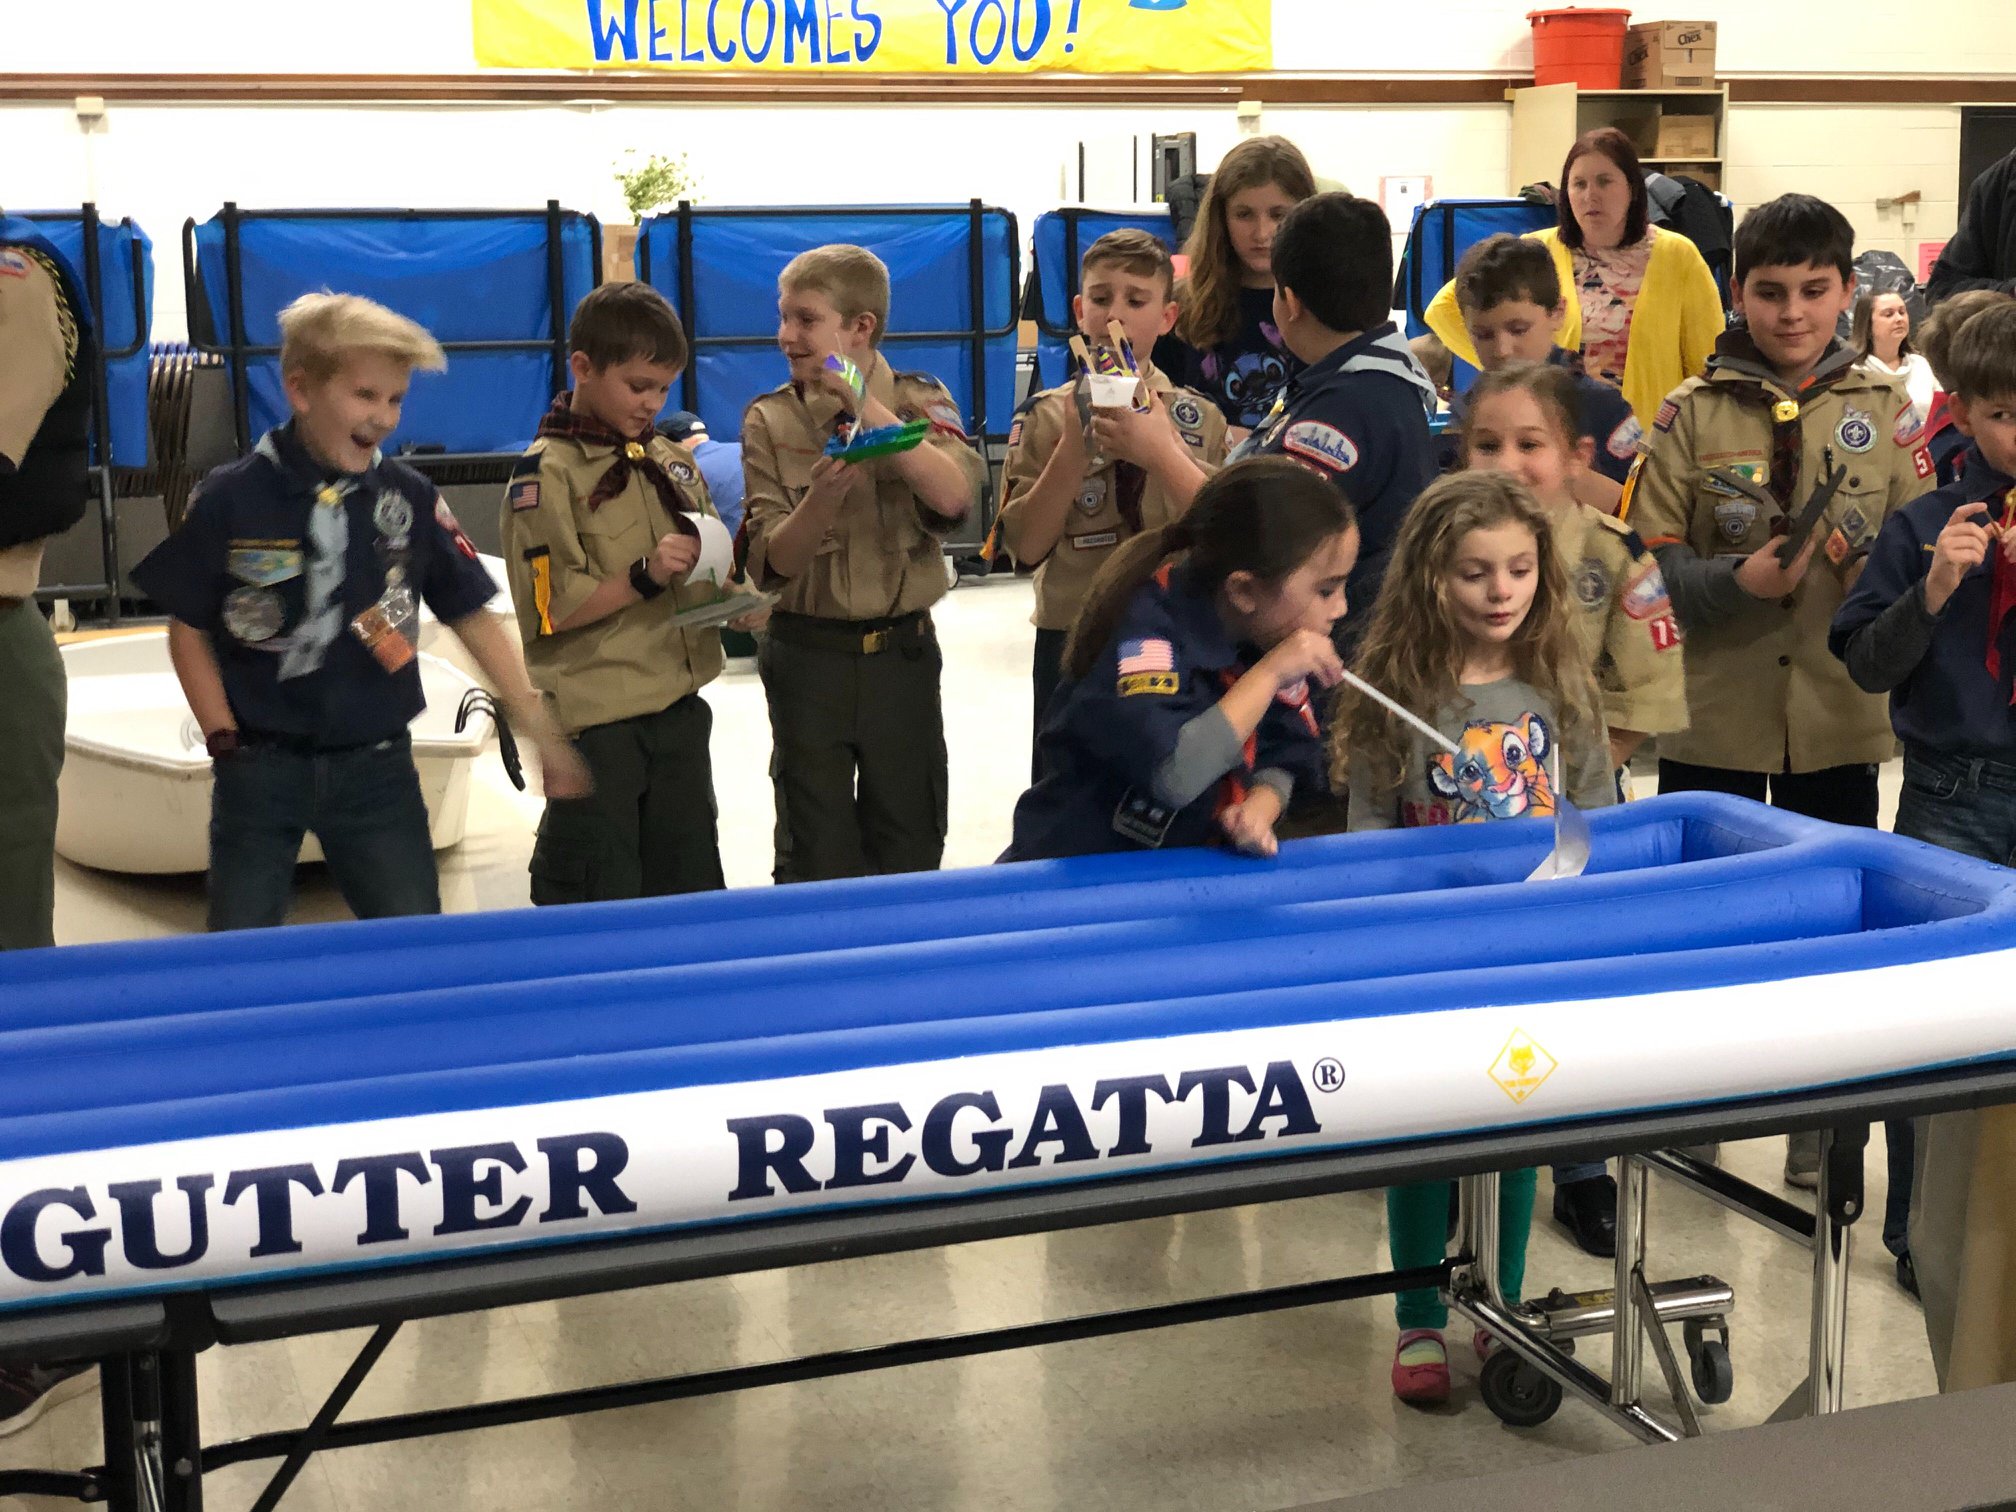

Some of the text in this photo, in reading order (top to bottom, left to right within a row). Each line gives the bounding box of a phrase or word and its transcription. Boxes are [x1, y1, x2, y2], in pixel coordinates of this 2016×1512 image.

[587, 0, 1080, 65] WELCOMES YOU!
[1677, 31, 1702, 46] Chex
[1, 1131, 637, 1282] GUTTER
